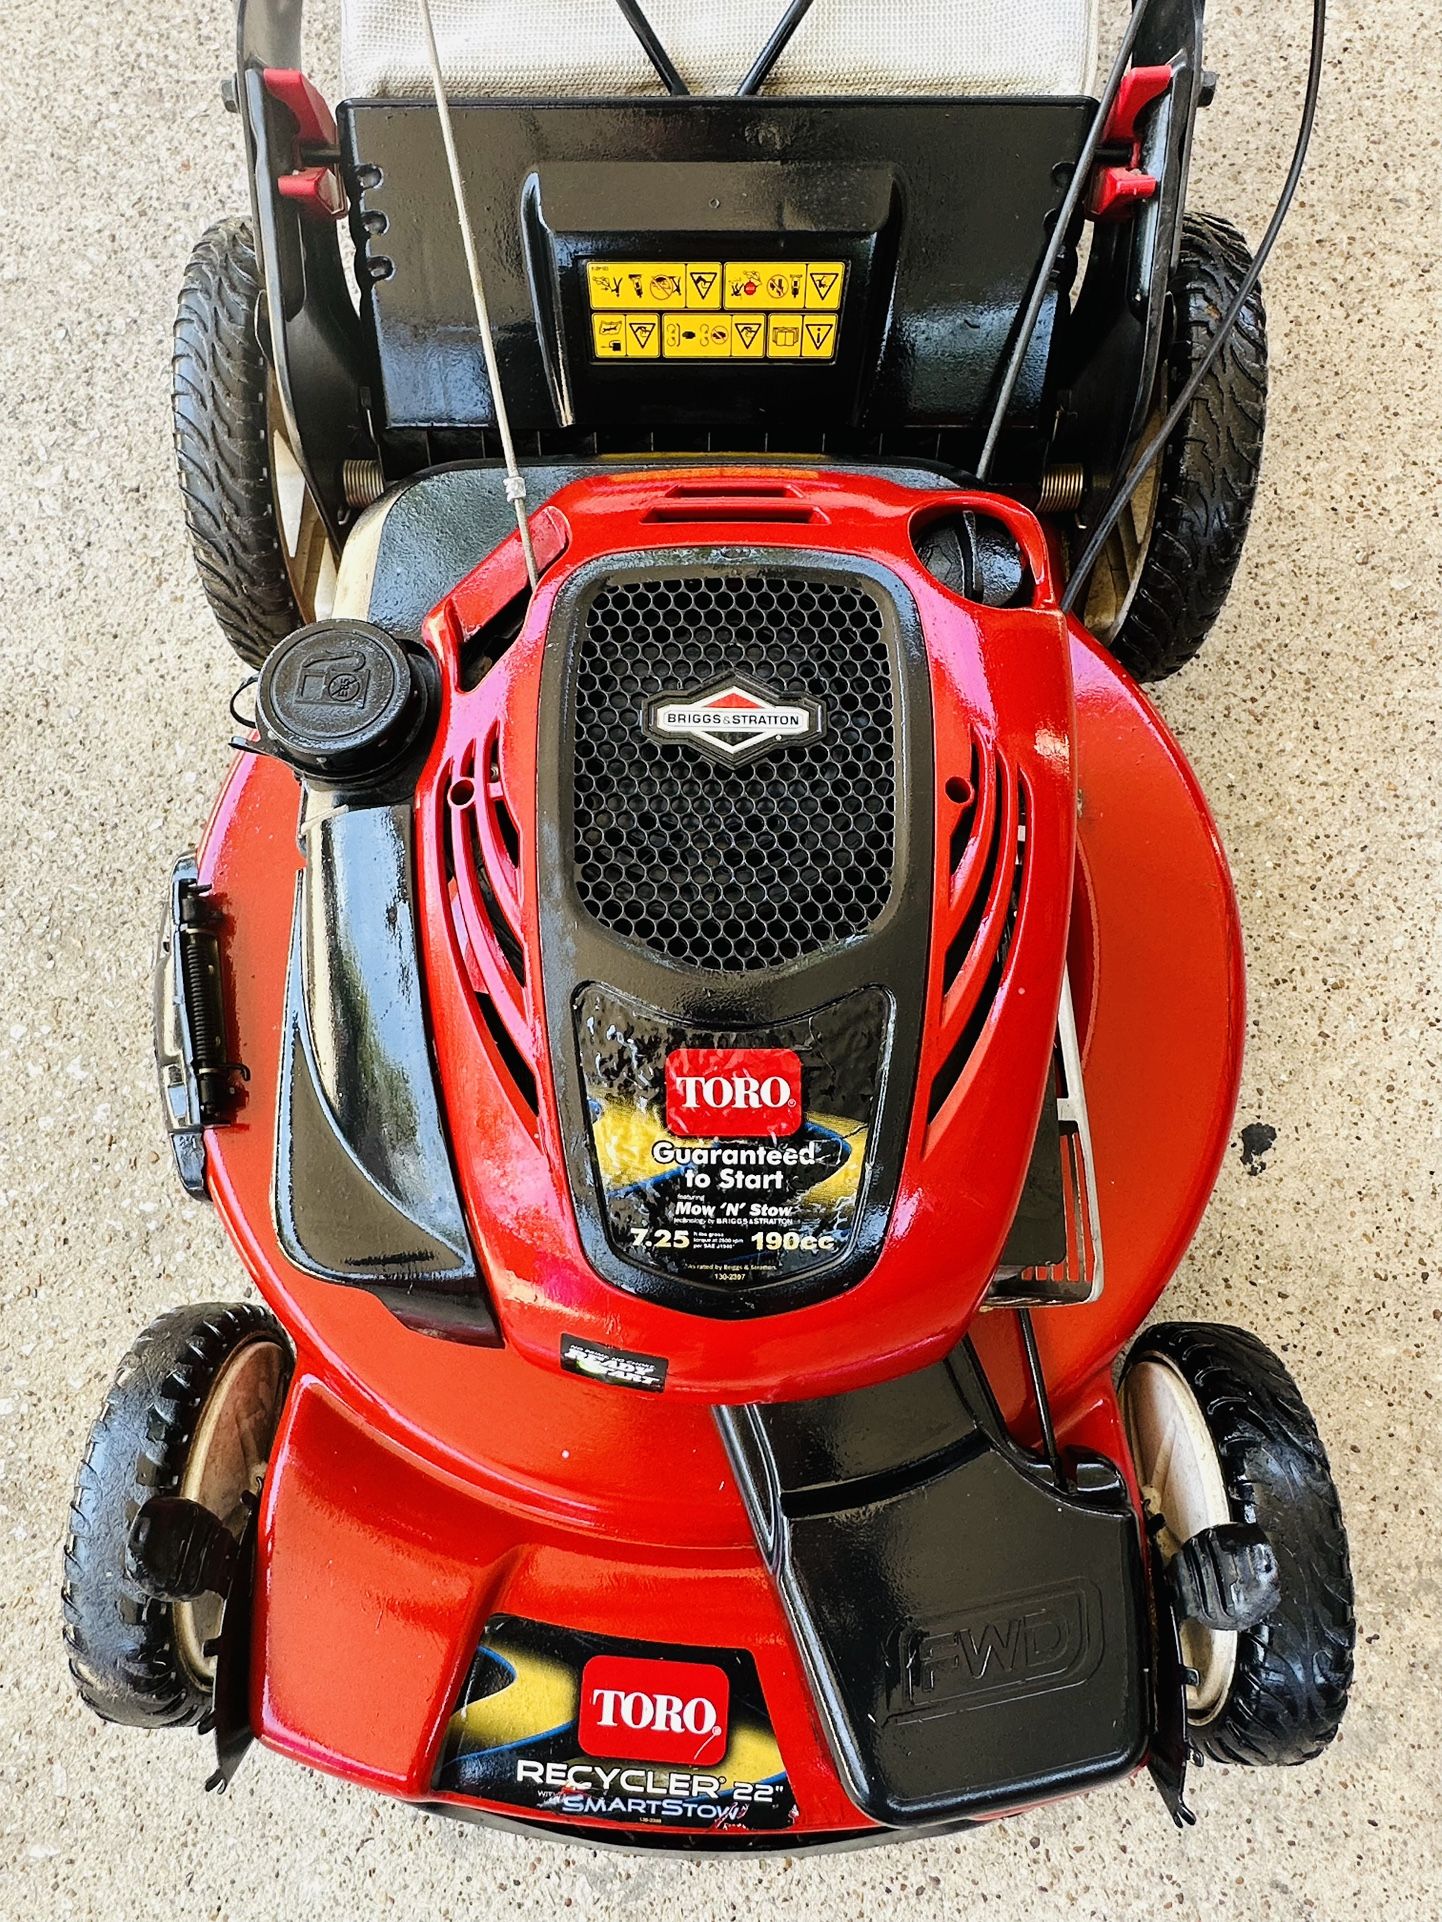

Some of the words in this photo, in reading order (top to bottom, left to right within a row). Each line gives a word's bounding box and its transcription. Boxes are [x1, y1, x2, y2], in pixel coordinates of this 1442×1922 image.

[676, 1076, 791, 1109] TORO
[652, 1141, 816, 1166] Guaranteed
[684, 1170, 711, 1189] to
[719, 1169, 784, 1189] Start
[673, 1217, 706, 1225] technology
[675, 1201, 716, 1217] Mow
[749, 1203, 795, 1217] Stow
[630, 1227, 690, 1249] 7.25
[751, 1231, 835, 1251] 190cc
[921, 1609, 1069, 1692] FWD
[592, 1689, 716, 1734] TORO
[732, 1783, 784, 1802] 22"
